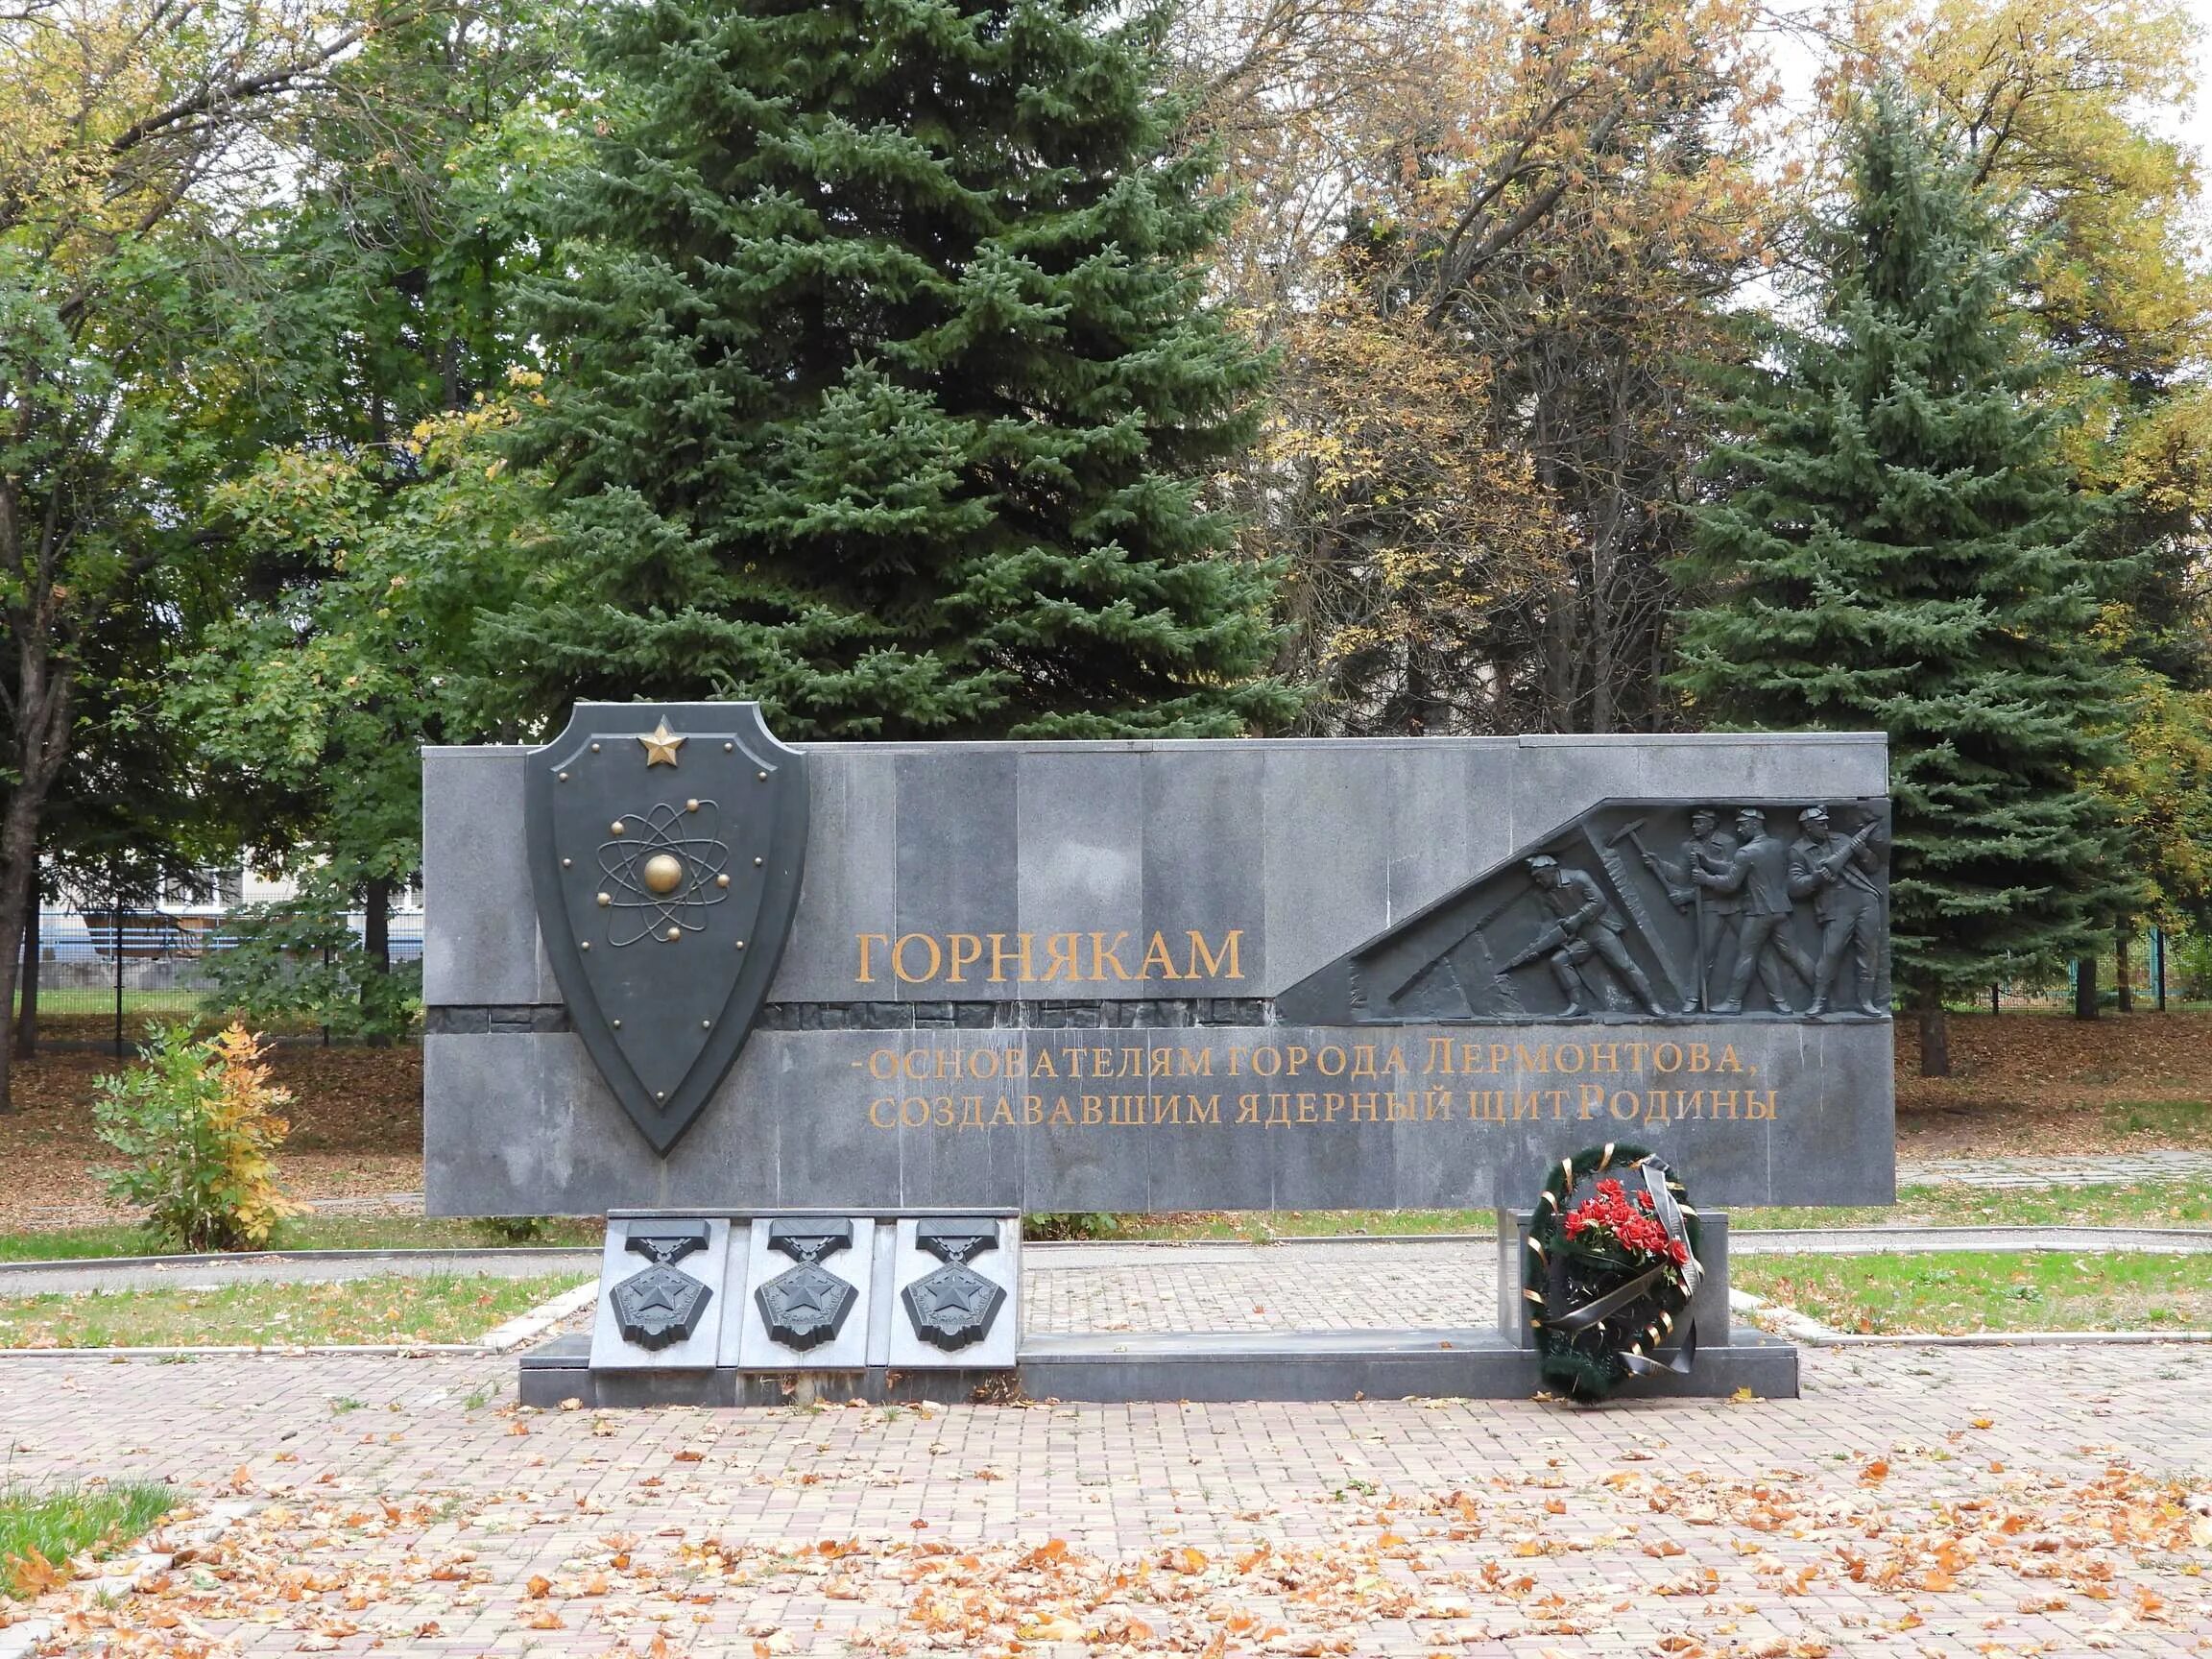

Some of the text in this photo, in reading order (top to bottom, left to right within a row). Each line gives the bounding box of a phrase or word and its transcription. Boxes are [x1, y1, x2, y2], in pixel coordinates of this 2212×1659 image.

[855, 928, 1245, 984] ГОРНЯКАМ
[1227, 1044, 1406, 1080] ГОРОДА
[1423, 1036, 1757, 1076] ЛЕРМОНТОВА,
[868, 1083, 1779, 1131] СОЗДАВАВШИМ ЯДЕРНЫЙ ЩИТ РОДИНЫ
